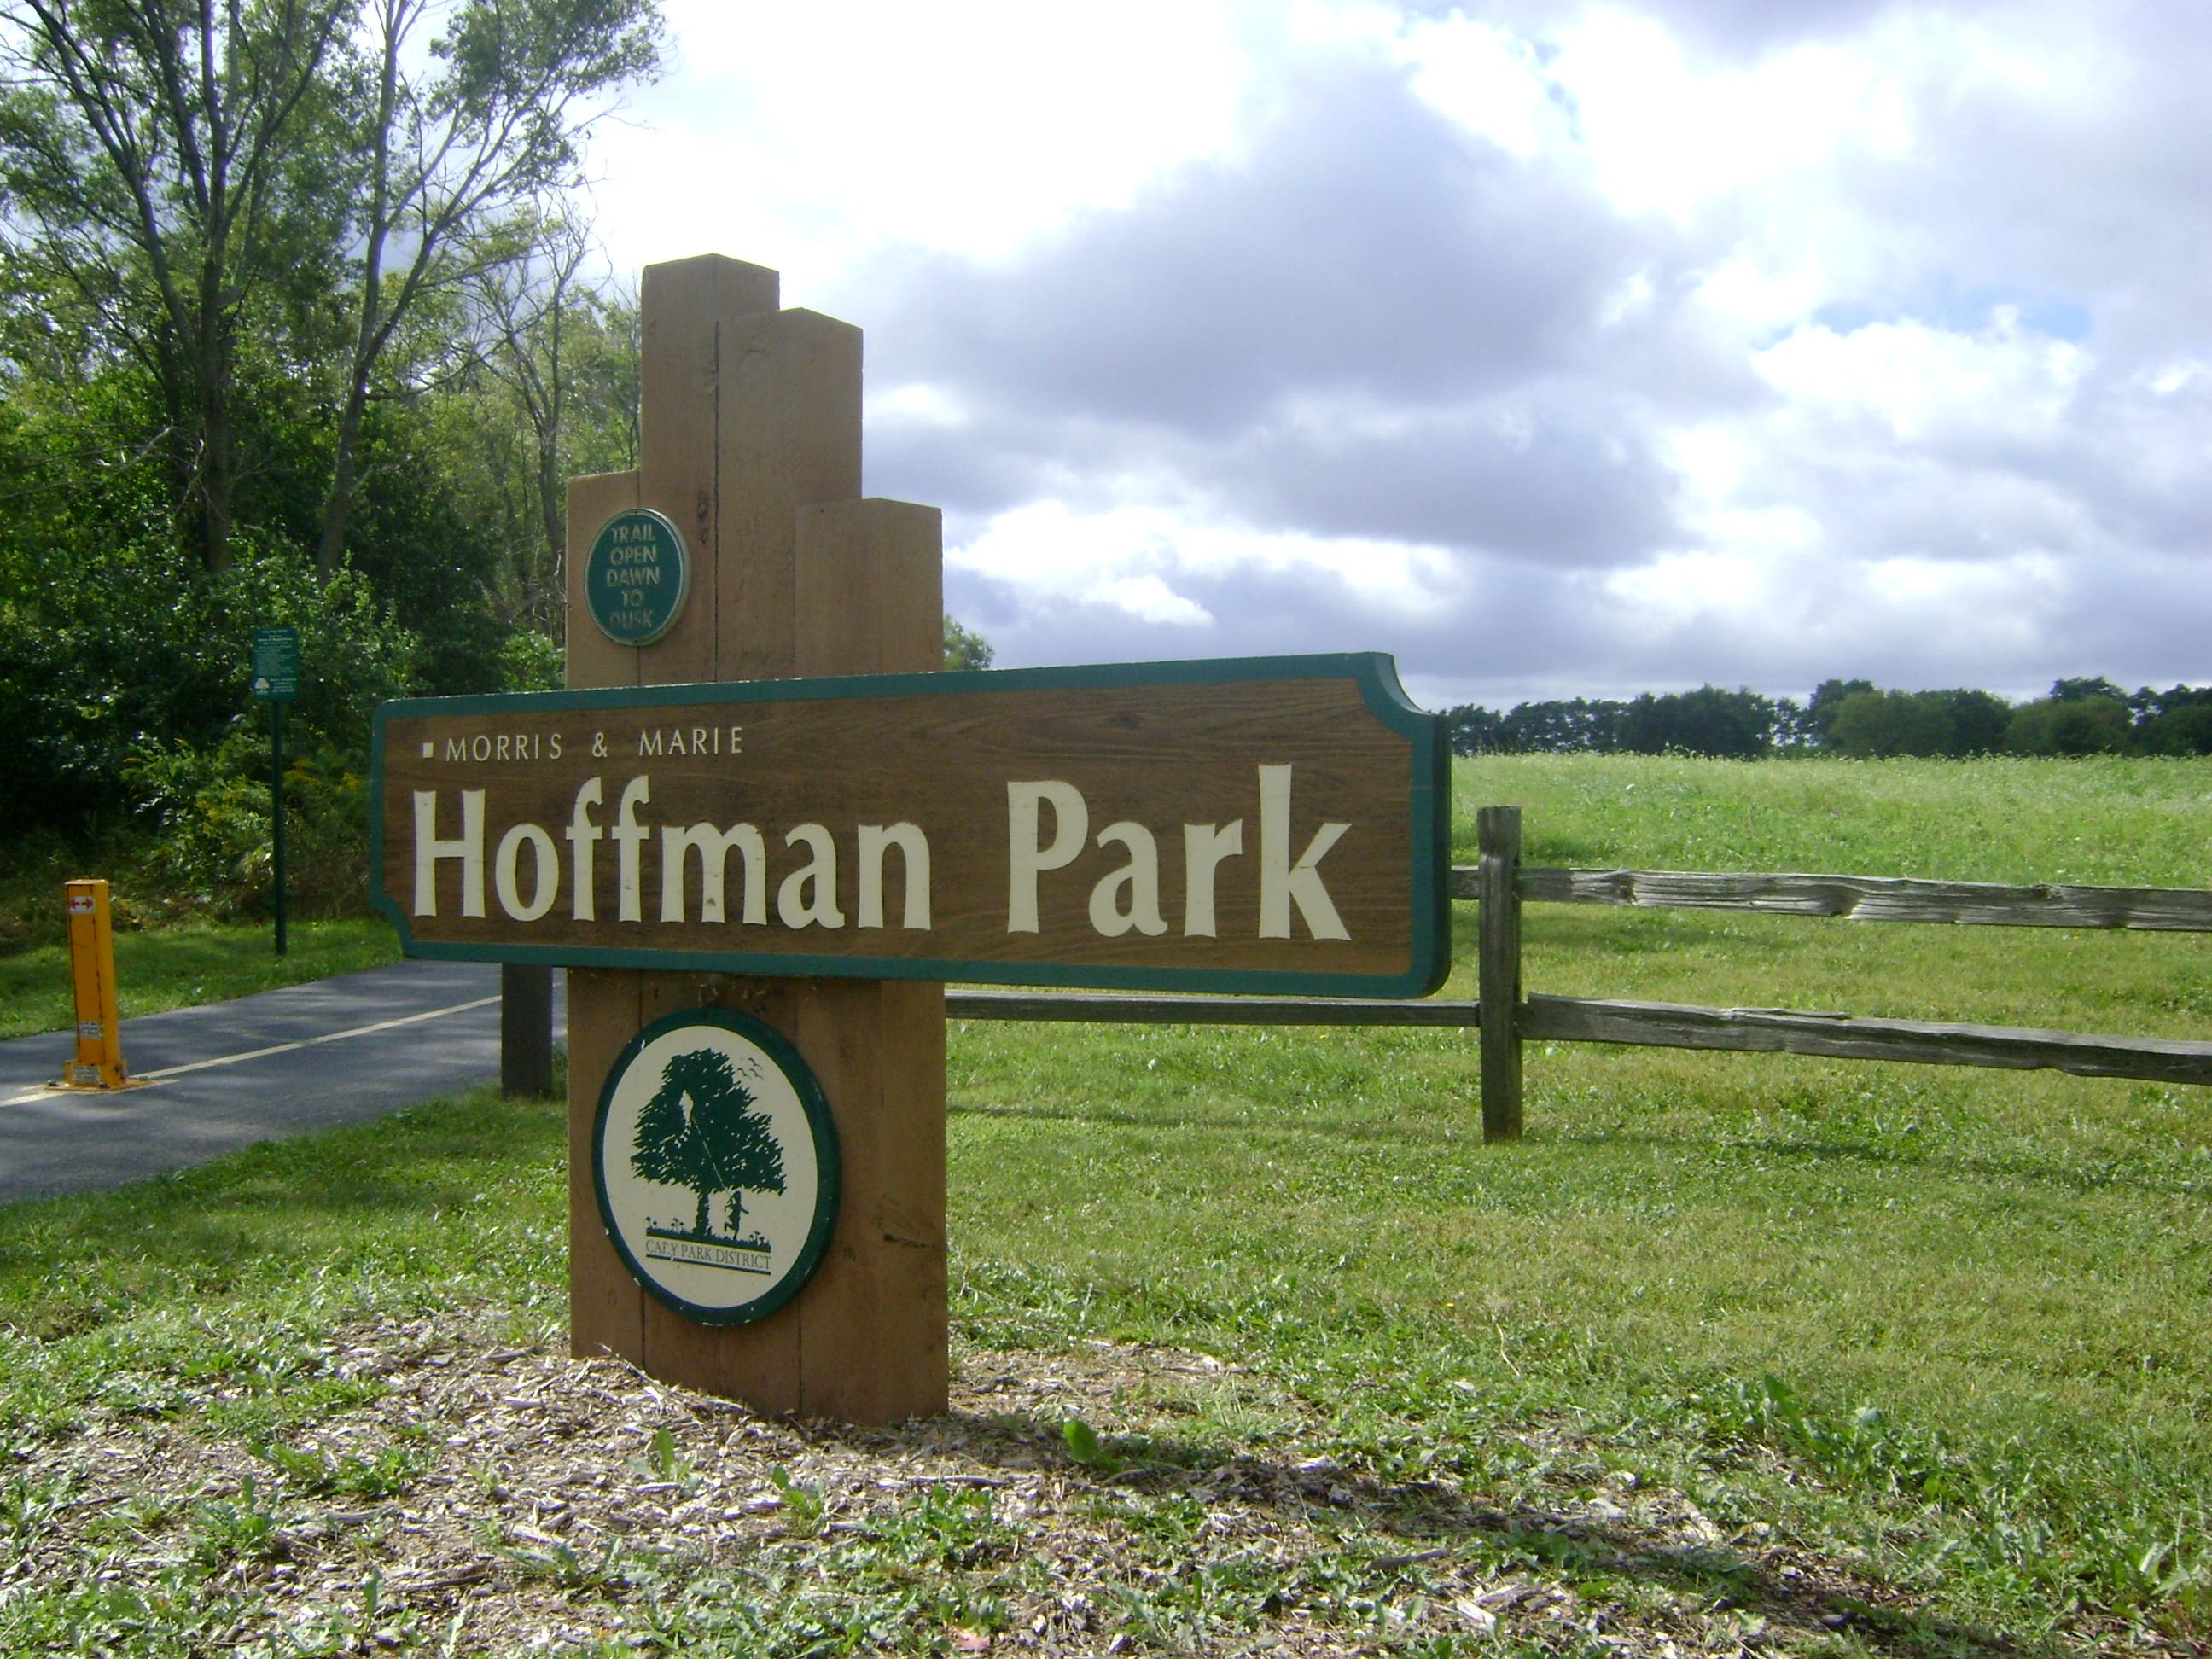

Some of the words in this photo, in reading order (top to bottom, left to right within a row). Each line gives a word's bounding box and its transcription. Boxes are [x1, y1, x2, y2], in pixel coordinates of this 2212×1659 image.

[611, 524, 656, 544] TRAIL
[610, 544, 657, 565] OPEN
[606, 567, 661, 587] DAWN
[621, 588, 645, 607] TO
[445, 734, 563, 761] MORRIS
[591, 732, 608, 758] &
[638, 727, 743, 757] MARIE
[412, 774, 932, 932] Hoffman
[1005, 764, 1353, 941] Park
[681, 1244, 713, 1261] PARK
[715, 1249, 772, 1269] DISTRICT
